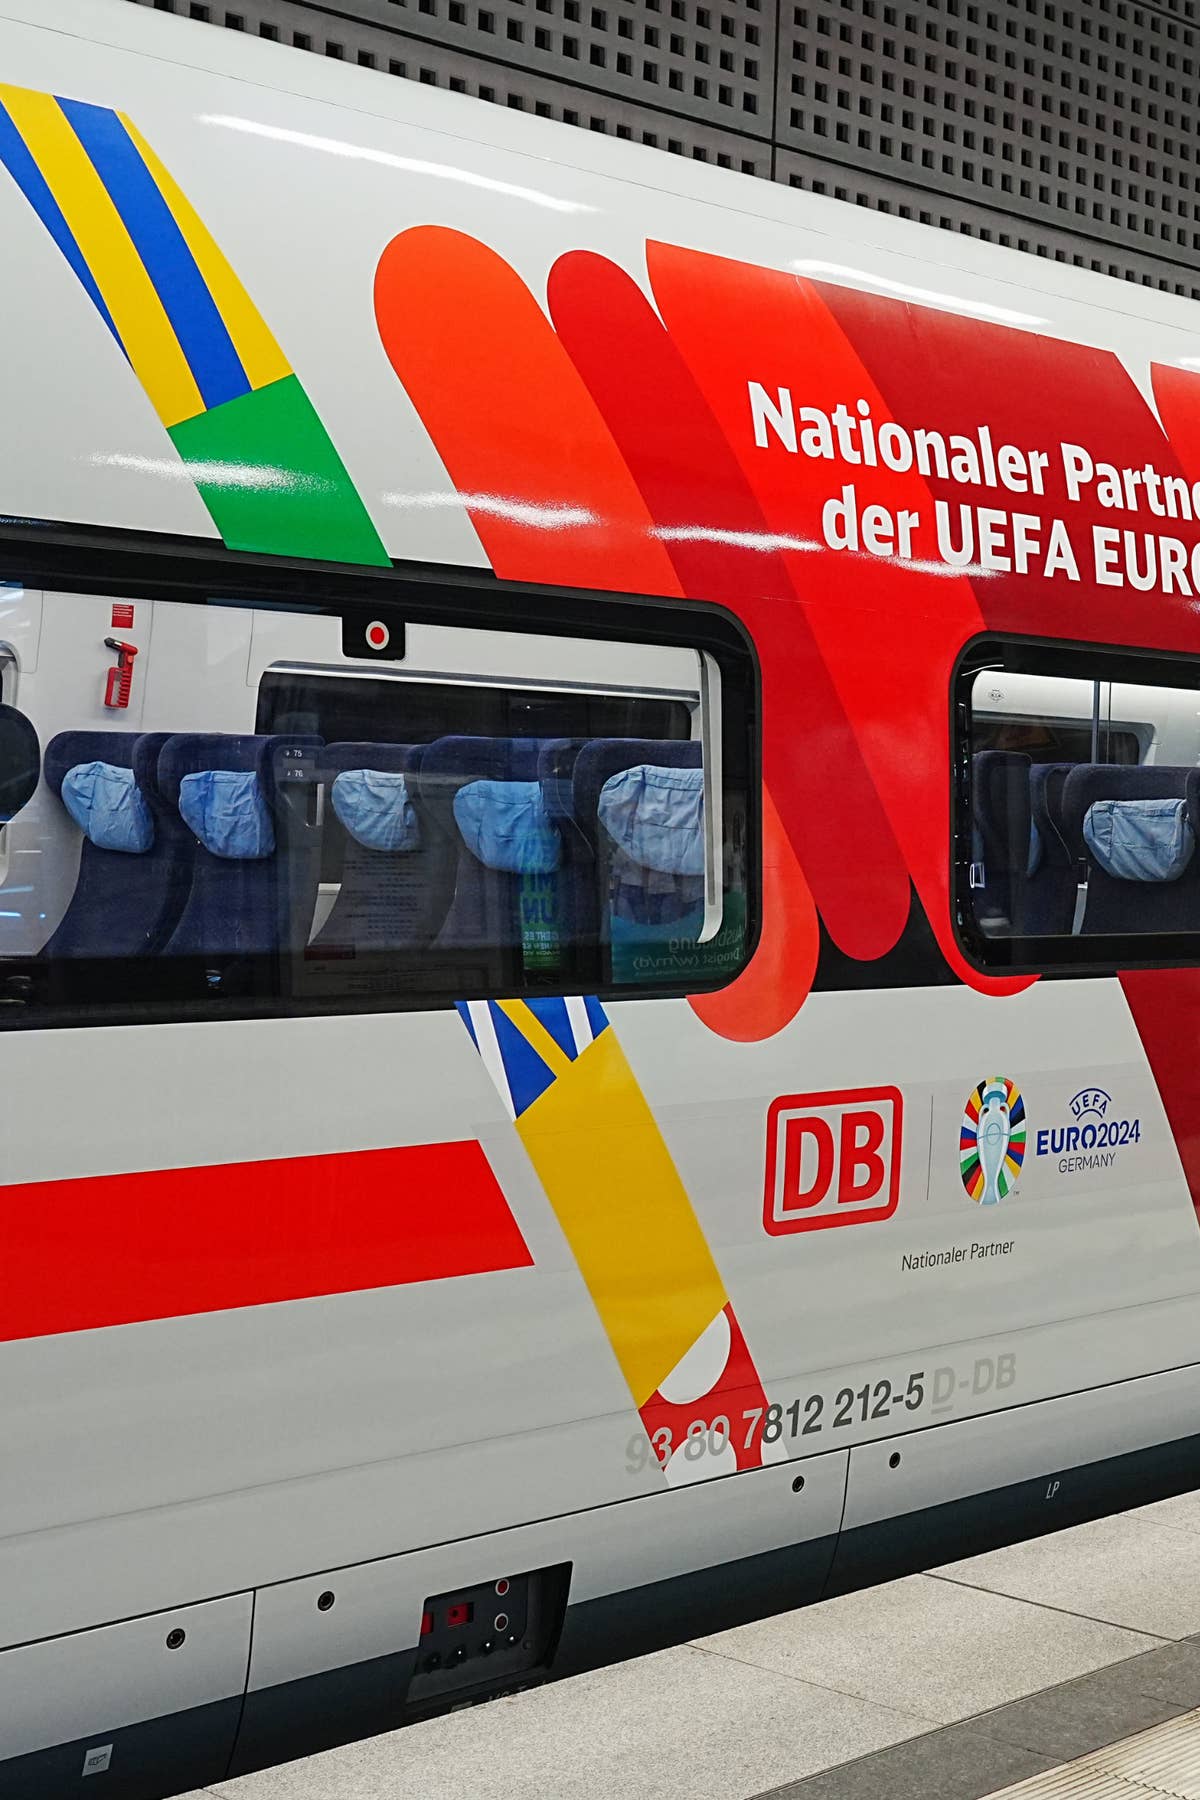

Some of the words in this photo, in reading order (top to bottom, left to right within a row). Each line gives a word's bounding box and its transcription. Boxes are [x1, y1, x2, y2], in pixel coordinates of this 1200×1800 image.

[748, 381, 1049, 495] Nationaler
[822, 484, 919, 558] der
[935, 500, 1081, 582] UEFA
[1071, 1093, 1108, 1116] UEFA
[782, 1110, 886, 1212] DB
[1058, 1152, 1117, 1173] GERMANY
[901, 1246, 967, 1271] Nationaler
[970, 1240, 1015, 1260] Partner
[625, 1426, 673, 1474] 93
[684, 1414, 730, 1461] 80
[742, 1394, 824, 1450] 7812
[832, 1371, 925, 1428] 212-5
[930, 1352, 1016, 1414] D-DB
